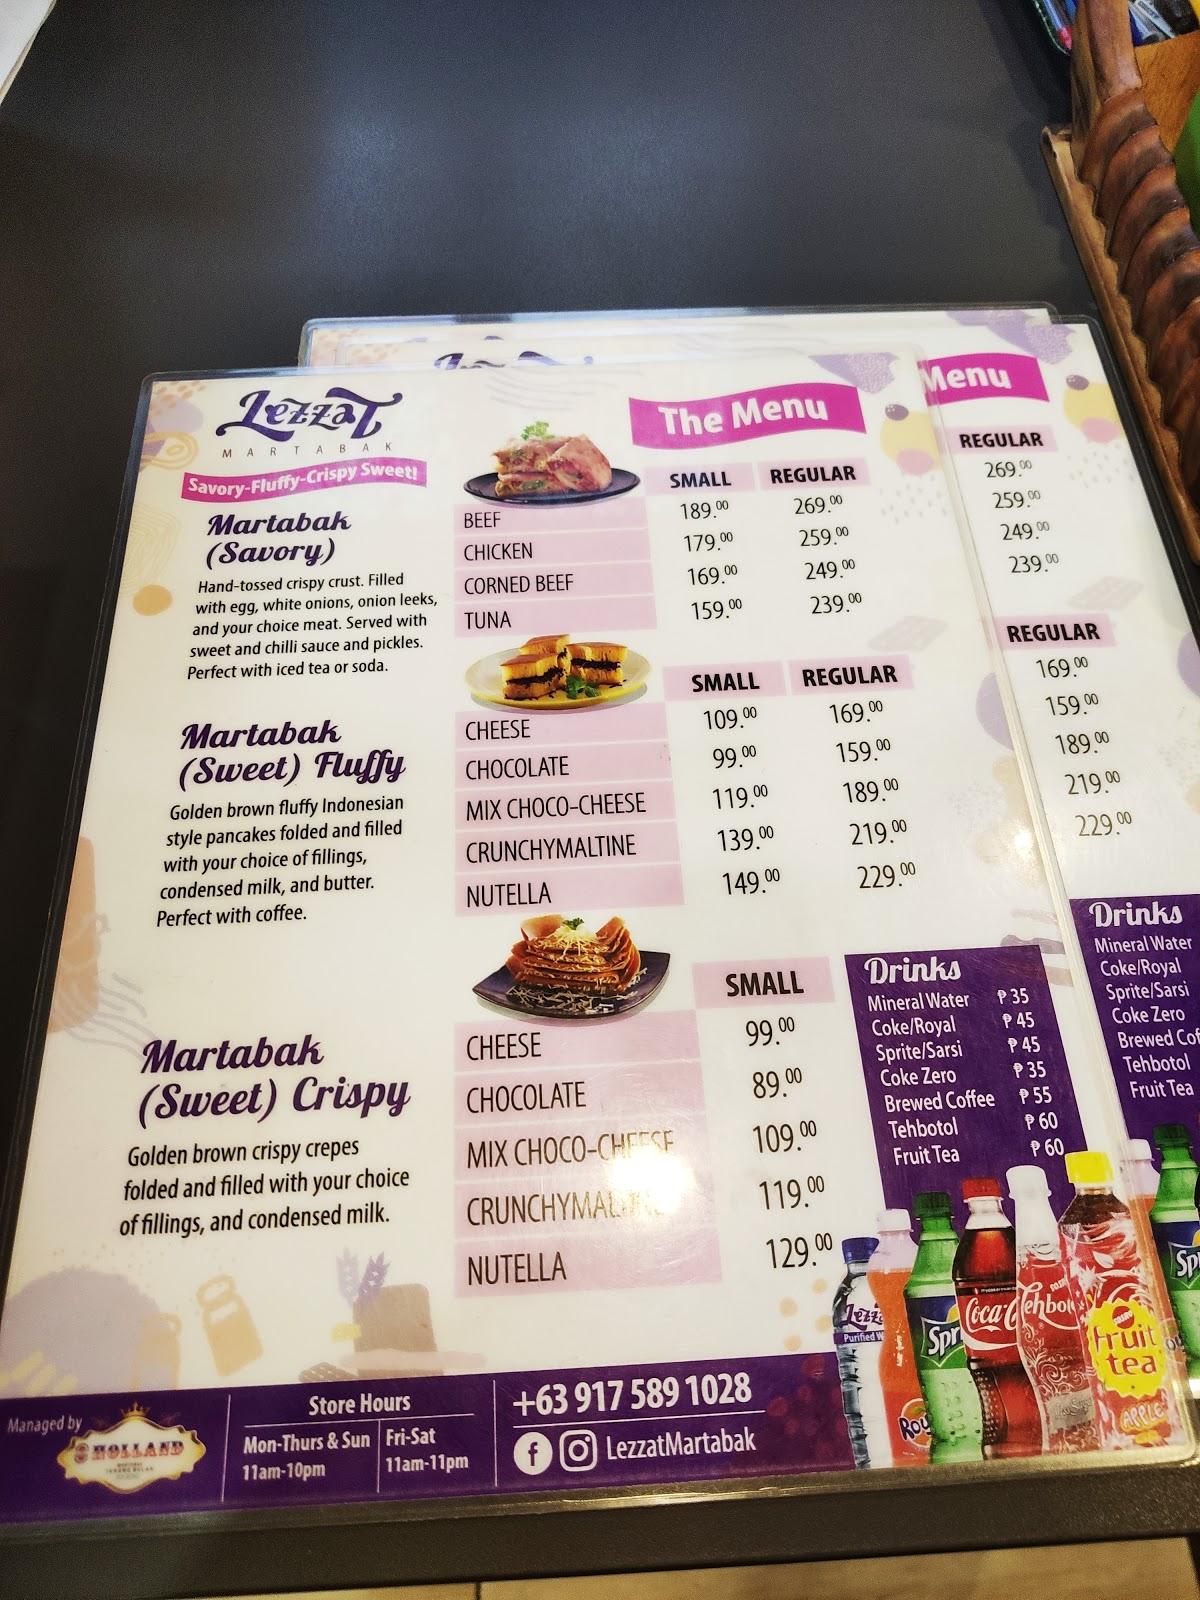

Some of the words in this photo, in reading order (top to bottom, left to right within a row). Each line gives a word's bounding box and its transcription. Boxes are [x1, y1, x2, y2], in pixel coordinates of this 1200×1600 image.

[919, 365, 1012, 393] Menu
[657, 406, 723, 435] The
[731, 397, 828, 429] Menu
[222, 443, 390, 459] MARTABAK
[959, 432, 1043, 448] REGULAR
[360, 461, 417, 481] Sweet!
[670, 471, 732, 488] SMALL
[770, 466, 856, 484] REGULAR
[207, 511, 351, 536] Martabak
[464, 512, 501, 528] BEEF
[206, 538, 335, 570] (Savory)
[464, 542, 532, 561] CHICKEN
[198, 577, 283, 593] Hand-tossed
[286, 577, 325, 592] crispy
[328, 576, 364, 588] crust.
[369, 572, 404, 586] Filled
[464, 576, 530, 595] CORNED
[536, 573, 573, 592] BEEF
[196, 600, 226, 614] with
[230, 602, 258, 616] egg,
[263, 598, 302, 611] white
[305, 597, 353, 610] onions,
[358, 594, 396, 607] onion
[400, 592, 437, 606] leeks,
[464, 611, 511, 630] TUNA
[1007, 623, 1100, 642] REGULAR
[187, 665, 237, 680] Perfect
[241, 663, 272, 677] with
[277, 661, 304, 676] iced
[308, 662, 330, 674] tea
[334, 663, 348, 673] or
[352, 658, 388, 673] soda.
[802, 665, 898, 687] REGULAR
[692, 672, 760, 692] SMALL
[180, 719, 342, 750] Martabak
[466, 719, 531, 741] CHEESE
[179, 753, 300, 792] (Sweet)
[314, 749, 406, 784] Fluffy
[466, 756, 569, 780] CHOCOLATE
[170, 803, 222, 820] Golden
[227, 802, 274, 818] brown
[279, 798, 318, 818] fluffy
[323, 796, 403, 813] Indonesian
[467, 799, 502, 821] MIX
[507, 792, 646, 819] CHOCO-CHEESE
[466, 834, 636, 863] CRUNCHYMALTINE
[160, 879, 243, 899] condensed
[247, 877, 285, 896] milk,
[290, 875, 319, 893] and
[324, 874, 374, 891] butter.
[467, 882, 552, 908] NUTELLA
[157, 909, 212, 927] Perfect
[216, 906, 251, 924] with
[256, 904, 306, 922] coffee.
[1089, 901, 1183, 927] Drinks
[1094, 935, 1149, 953] Mineral
[1149, 935, 1192, 951] Water
[864, 956, 961, 984] Drinks
[1100, 957, 1181, 978] Coke/Royal
[726, 971, 804, 997] SMALL
[1106, 980, 1190, 1004] Sprite/Sarsi
[868, 992, 924, 1012] Mineral
[925, 992, 969, 1008] Water
[872, 1015, 956, 1037] Coke/Royal
[1112, 1006, 1149, 1024] Coke
[1150, 1006, 1185, 1022] Zero
[467, 1032, 541, 1061] CHEESE
[1117, 1029, 1174, 1048] Brewed
[140, 1034, 324, 1074] Martabak
[876, 1040, 963, 1065] Sprite/Sarsi
[1122, 1053, 1191, 1073] Tehbotol
[880, 1068, 918, 1086] Coke
[921, 1067, 956, 1084] Zero
[467, 1081, 586, 1113] CHOCOLATE
[1130, 1080, 1166, 1098] Fruit
[1166, 1079, 1194, 1096] Tea
[139, 1078, 277, 1129] (Sweet)
[293, 1076, 411, 1119] Crispy
[884, 1091, 943, 1112] Brewed
[946, 1089, 995, 1109] Coffee
[888, 1116, 958, 1138] Tehbotol
[128, 1145, 187, 1167] Golden
[193, 1143, 247, 1164] brown
[252, 1140, 301, 1164] crispy
[306, 1140, 359, 1162] crepes
[468, 1140, 508, 1169] MIX
[893, 1146, 931, 1165] Fruit
[931, 1145, 960, 1163] Tea
[120, 1214, 140, 1236] of
[141, 1212, 205, 1239] fillings,
[210, 1209, 243, 1231] and
[248, 1203, 341, 1229] condensed
[347, 1201, 389, 1224] milk.
[468, 1251, 567, 1286] NUTELLA
[844, 1332, 875, 1343] Purified
[1105, 1352, 1157, 1375] tea
[309, 1396, 356, 1416] Store
[360, 1393, 411, 1413] Hours
[513, 1383, 568, 1416] +63
[574, 1380, 623, 1413] 917
[631, 1377, 679, 1409] 589
[685, 1372, 752, 1405] 1028
[8, 1415, 65, 1436] Managed
[68, 1415, 82, 1433] by
[1123, 1402, 1164, 1428] APPLE
[243, 1434, 323, 1454] Mon-Thurs
[327, 1432, 339, 1449] &
[342, 1431, 370, 1449] Sun
[386, 1427, 436, 1446] Fri-Sat
[607, 1426, 756, 1460] LezzatMartabak
[92, 1440, 184, 1461] HOLLAND
[242, 1462, 325, 1481] 11am-10pm
[386, 1454, 469, 1473] 11am-11pm
